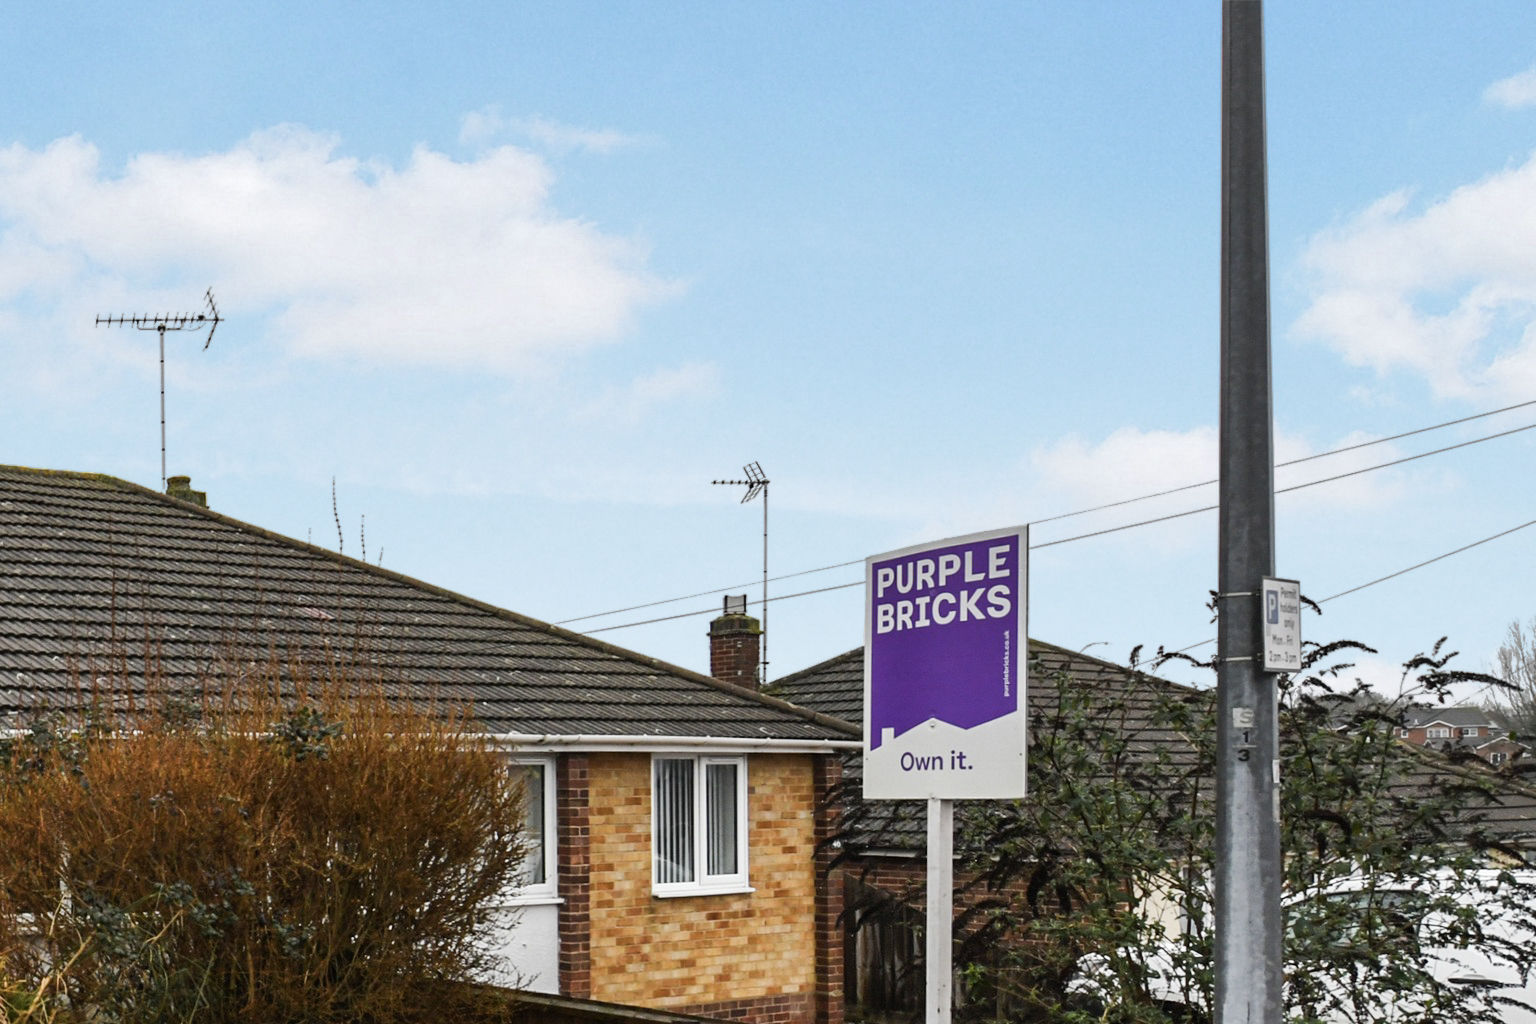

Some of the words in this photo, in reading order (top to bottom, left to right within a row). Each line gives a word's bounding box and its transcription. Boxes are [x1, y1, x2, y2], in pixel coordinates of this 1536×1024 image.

[877, 545, 1010, 598] PURPLE
[877, 585, 1011, 634] BRICKS
[1268, 593, 1277, 620] P
[1242, 731, 1249, 743] 1
[900, 752, 944, 771] Own
[950, 750, 973, 771] it.
[1238, 749, 1250, 762] 3
